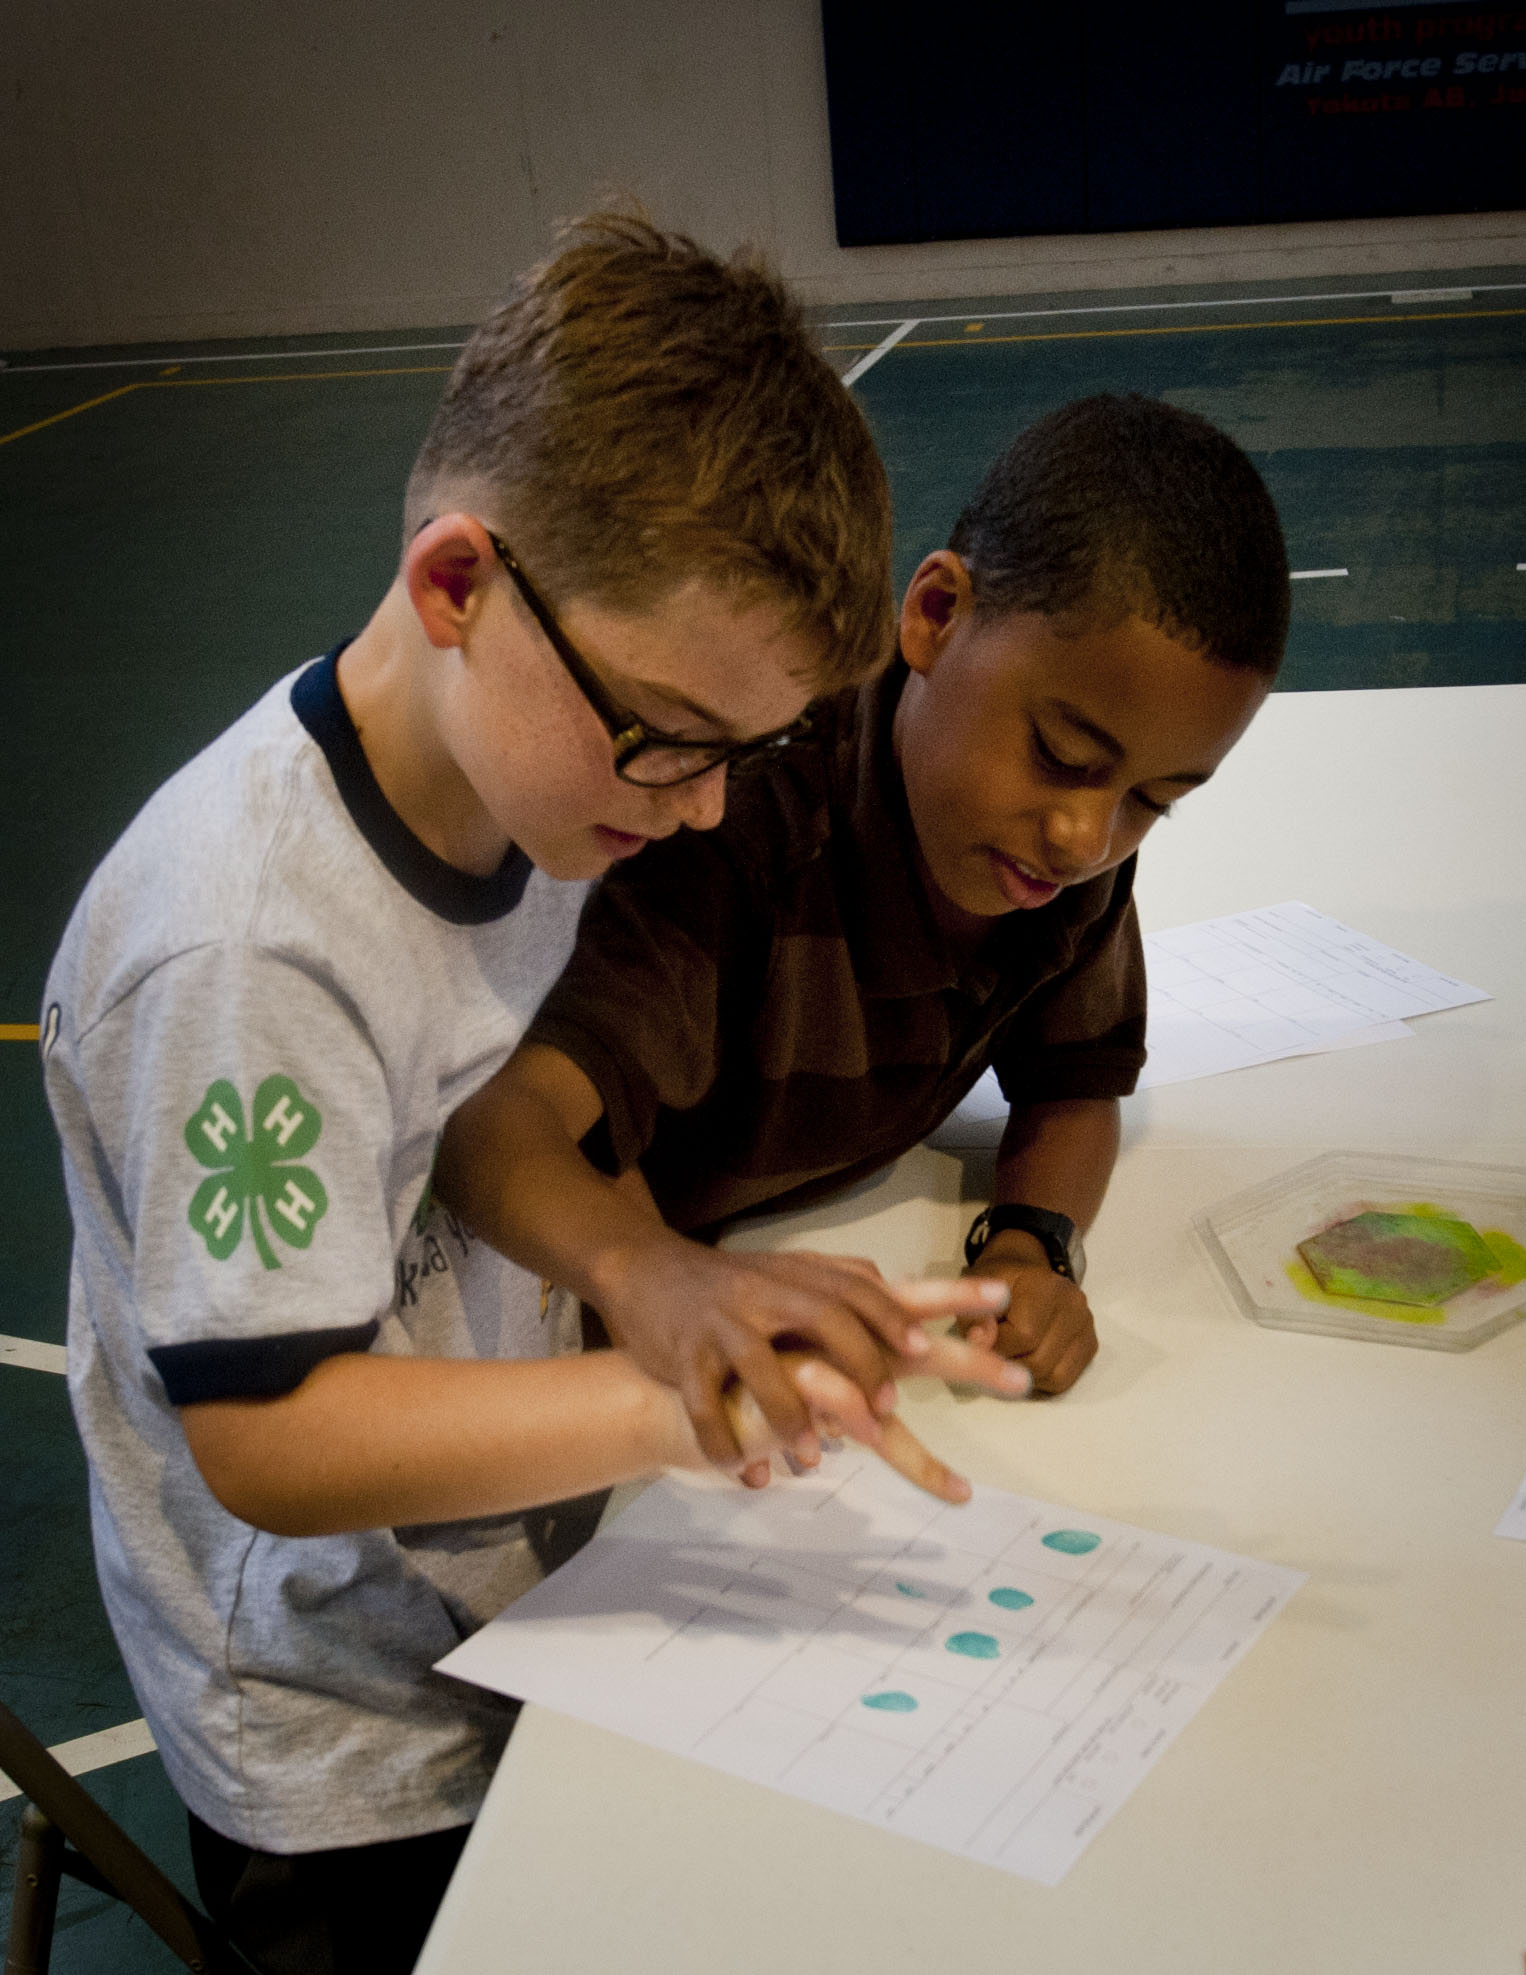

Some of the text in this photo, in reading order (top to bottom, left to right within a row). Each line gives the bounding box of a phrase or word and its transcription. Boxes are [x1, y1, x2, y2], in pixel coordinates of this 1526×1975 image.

[1304, 14, 1402, 52] youth
[1275, 61, 1331, 86] Air
[1340, 56, 1442, 82] Force
[201, 1102, 237, 1152] H
[263, 1094, 304, 1147] H
[204, 1186, 238, 1239] H
[274, 1179, 315, 1231] H
